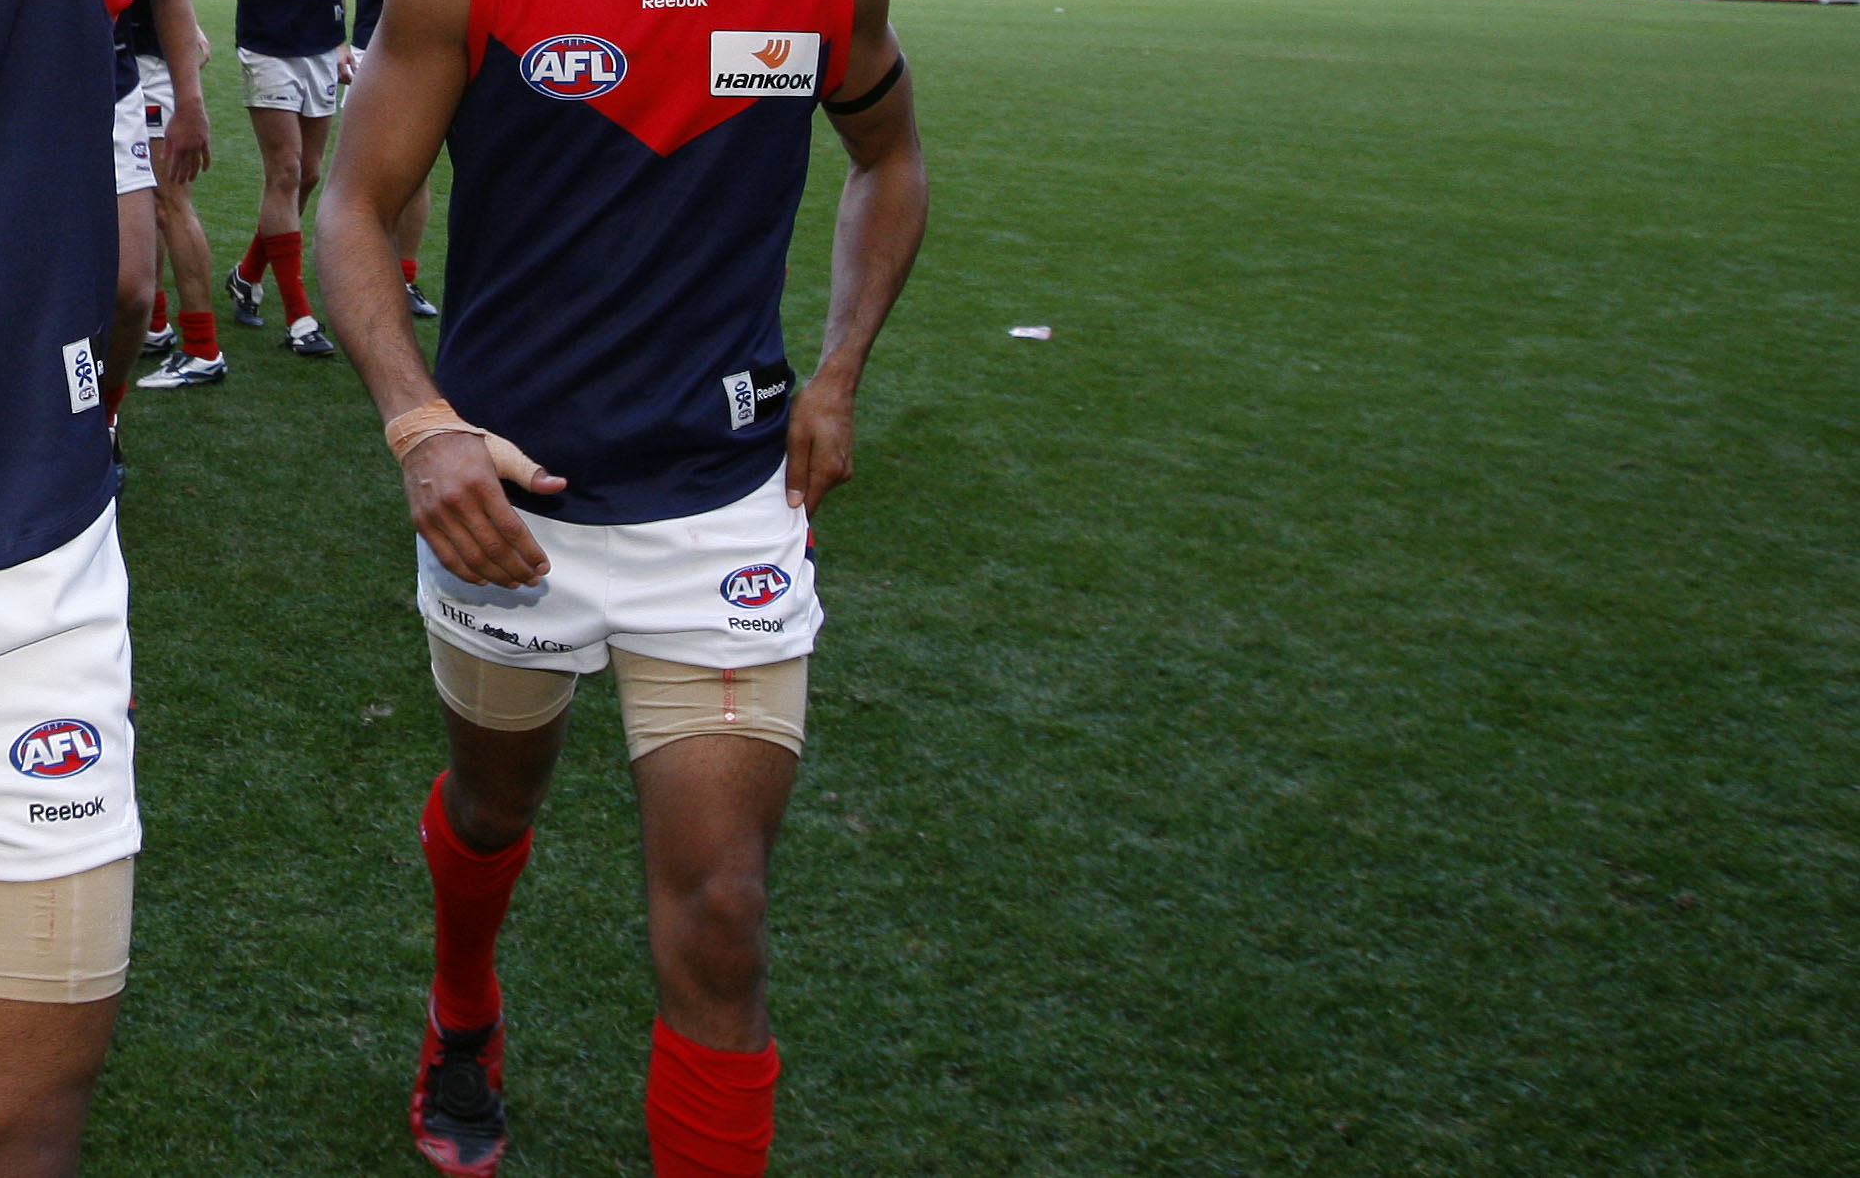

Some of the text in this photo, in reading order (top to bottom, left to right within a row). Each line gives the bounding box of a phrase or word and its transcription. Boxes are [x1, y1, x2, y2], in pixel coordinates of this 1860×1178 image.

[529, 50, 618, 82] AFL
[728, 571, 789, 602] AFL
[439, 600, 476, 630] THE
[728, 616, 786, 634] Reebok
[20, 728, 100, 772] AFL
[29, 795, 107, 824] Reebok
